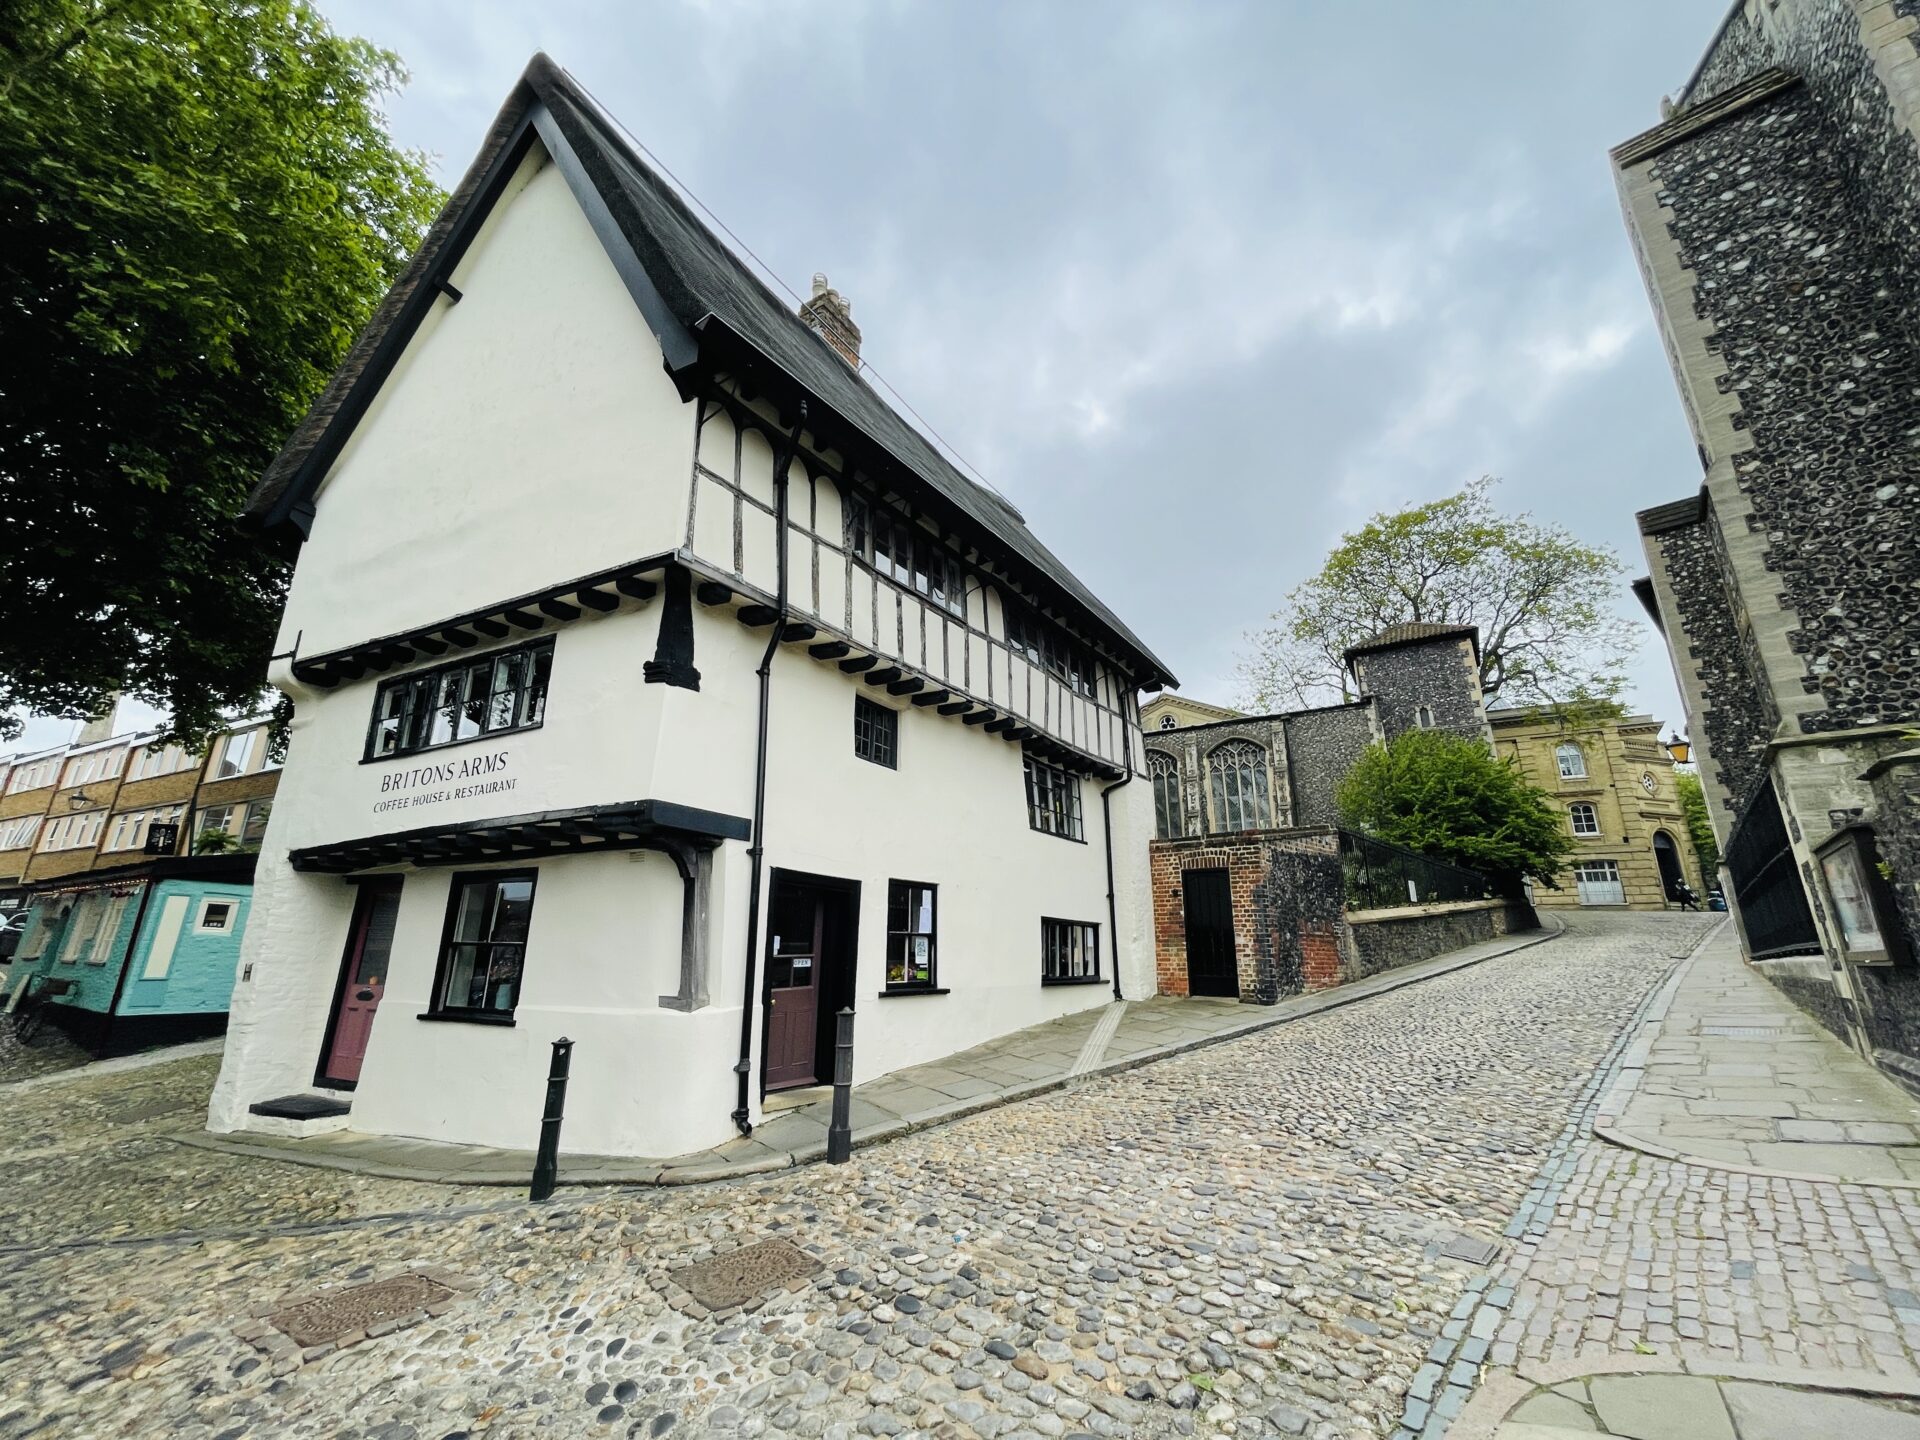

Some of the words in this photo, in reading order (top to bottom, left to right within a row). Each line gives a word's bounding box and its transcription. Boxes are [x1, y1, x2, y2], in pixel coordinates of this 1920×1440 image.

[381, 762, 455, 793] BRITONS
[458, 751, 509, 779] ARMS
[373, 797, 410, 813] COFFEE
[412, 791, 444, 807] HOUSE
[445, 791, 451, 801] &
[454, 778, 518, 800] RESTAURANT
